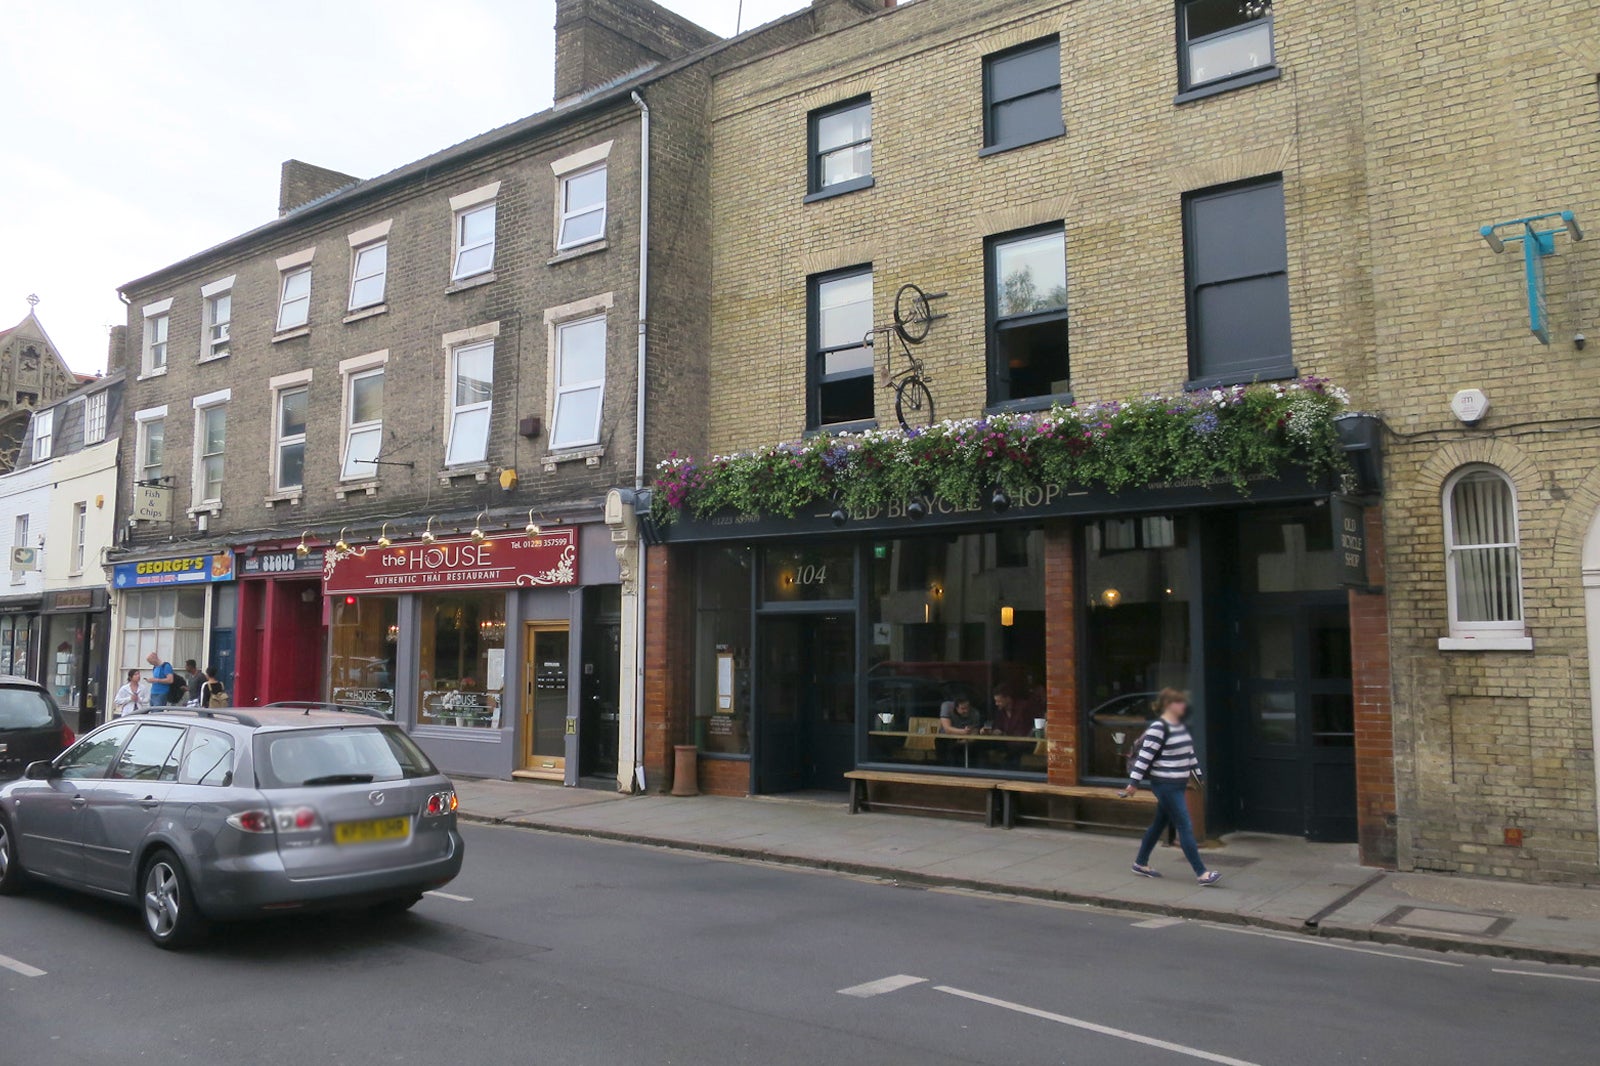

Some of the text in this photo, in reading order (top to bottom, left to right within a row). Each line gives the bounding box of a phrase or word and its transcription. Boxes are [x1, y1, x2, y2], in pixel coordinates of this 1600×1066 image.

[144, 489, 160, 499] Fish
[887, 491, 982, 518] BIYCLE
[1005, 482, 1061, 508] HOP
[140, 507, 162, 518] Chips
[1344, 518, 1356, 532] OLD
[544, 537, 567, 548] 357599
[382, 543, 493, 570] the HOUSE
[1344, 552, 1360, 568] SHOP
[136, 557, 205, 575] GEORGE'S
[374, 575, 417, 585] AUTHENTIC
[446, 570, 500, 581] RESTAURANT
[794, 564, 827, 585] 104
[353, 690, 377, 701] HOUSE
